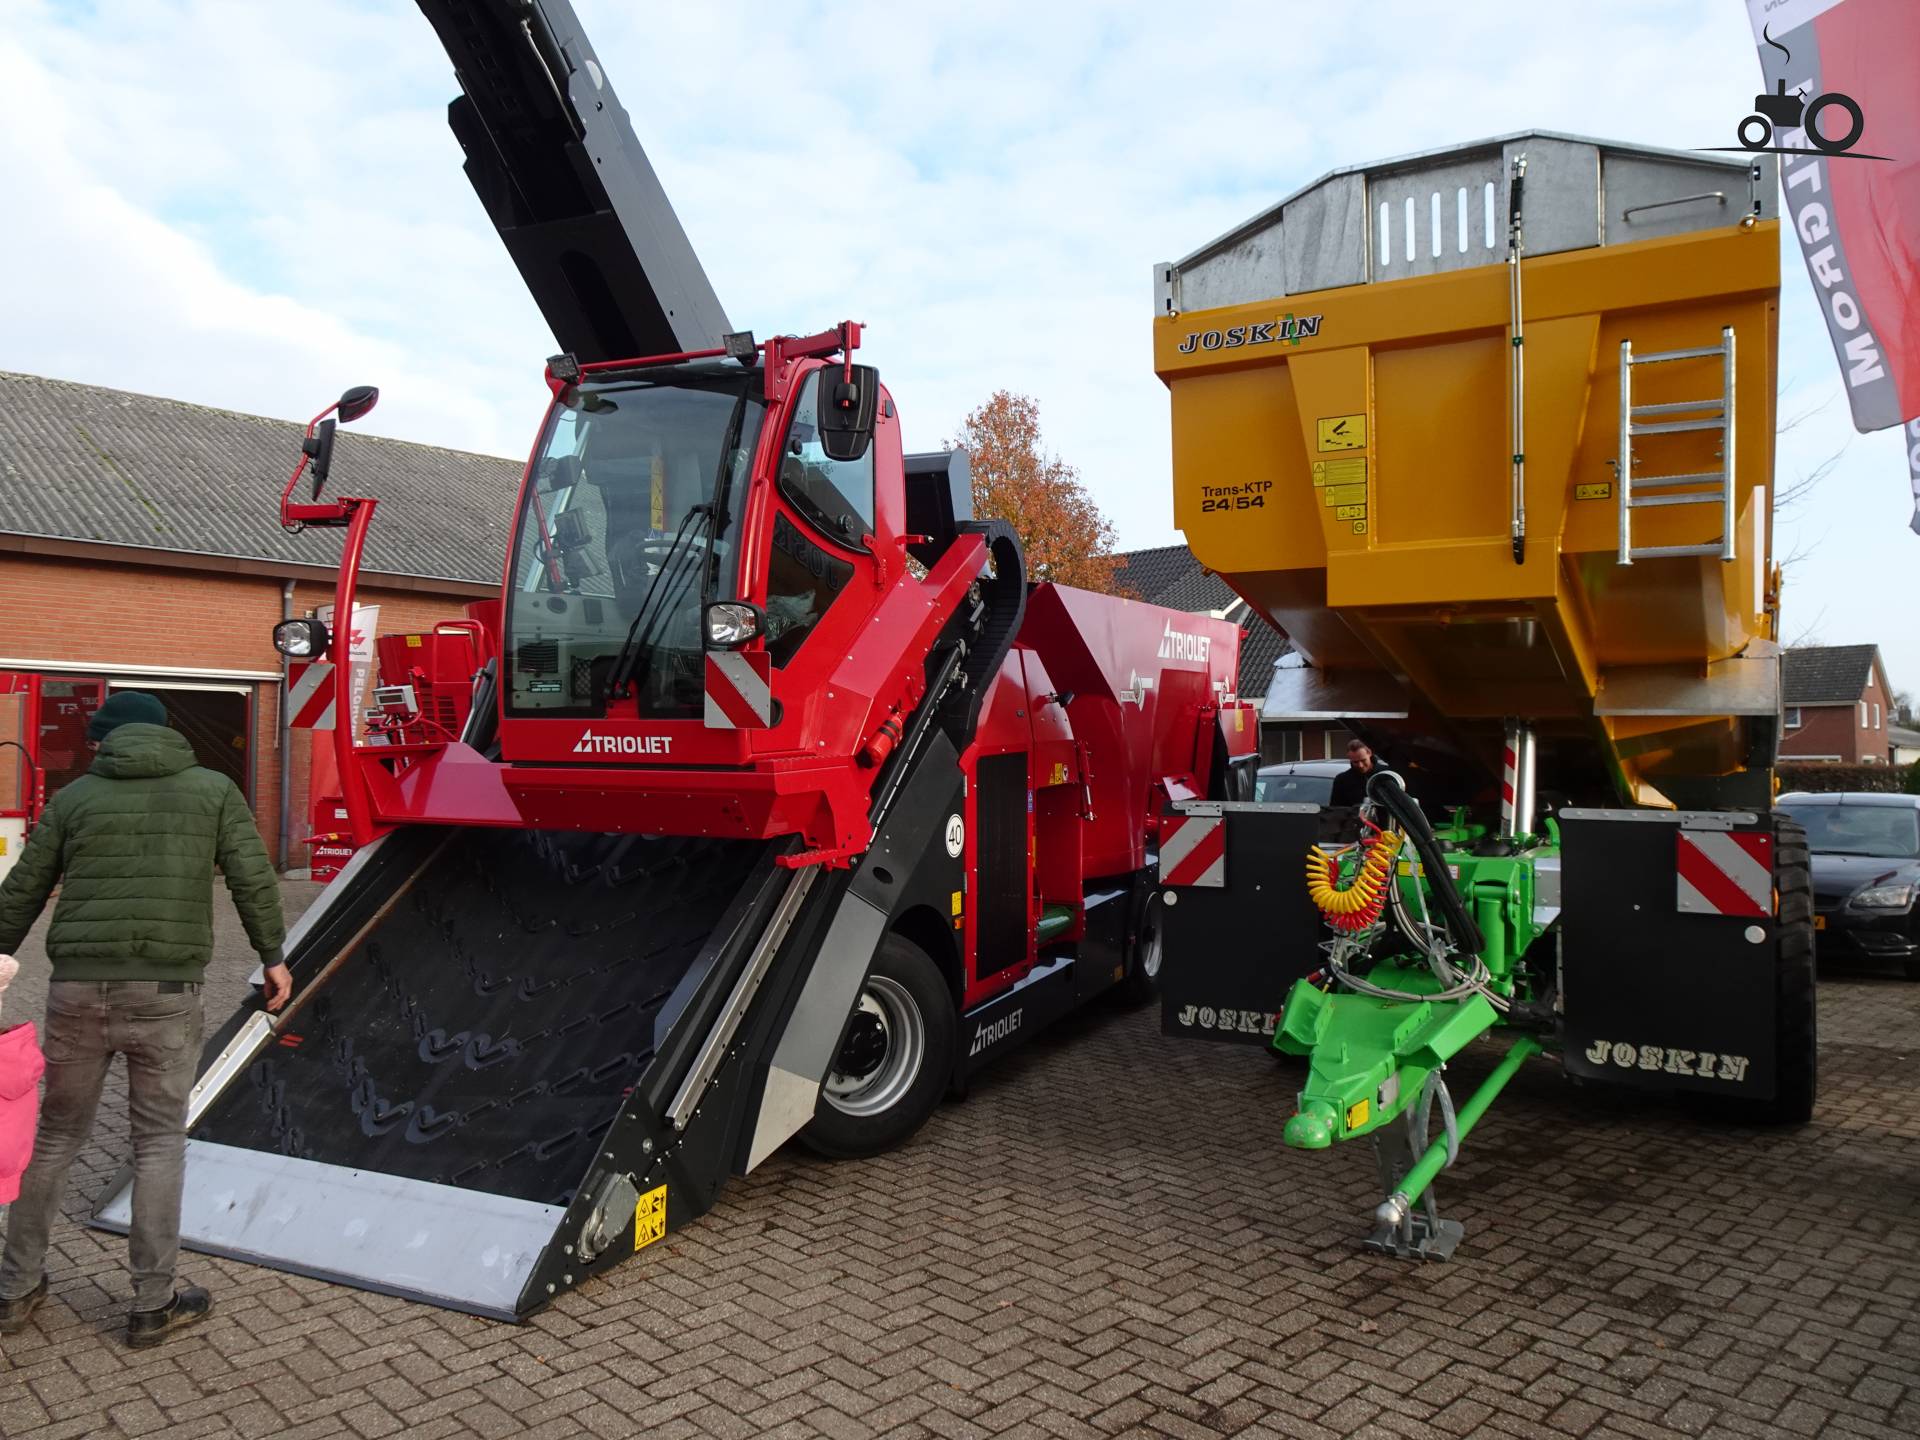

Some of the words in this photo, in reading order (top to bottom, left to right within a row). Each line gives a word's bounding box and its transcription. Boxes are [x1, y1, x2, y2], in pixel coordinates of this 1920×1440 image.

[1178, 315, 1323, 353] JOSKIN
[1202, 480, 1273, 498] Trans-KTP
[1202, 495, 1265, 513] 24/54
[1169, 631, 1211, 662] TRIOLIET
[592, 736, 673, 754] TRIOLIET
[948, 824, 962, 847] 40
[980, 1008, 1023, 1049] TRIOLIET
[1178, 1004, 1276, 1035] JOSKI
[1585, 1039, 1750, 1082] JOSKIN
